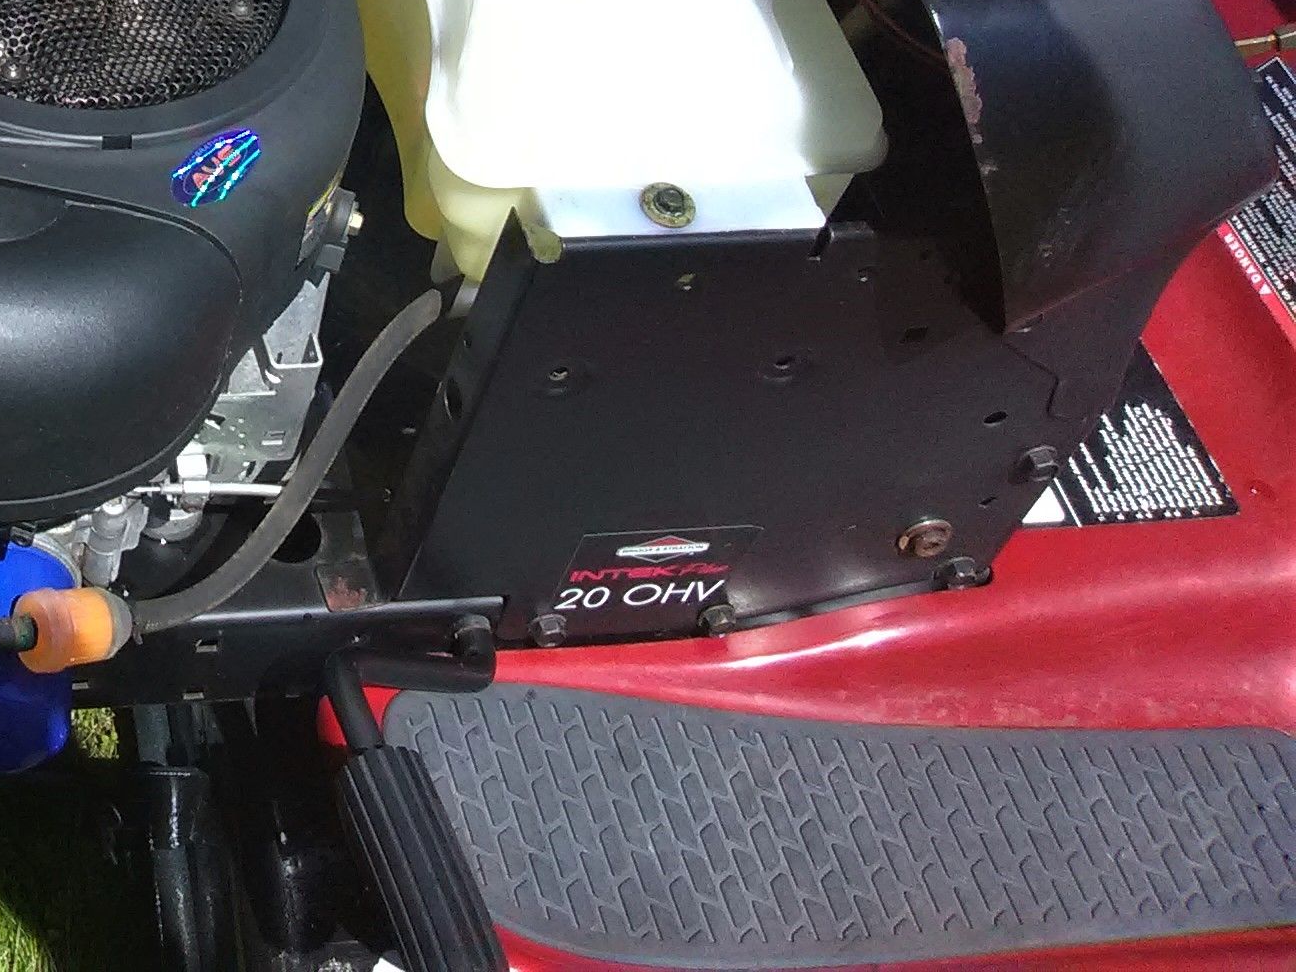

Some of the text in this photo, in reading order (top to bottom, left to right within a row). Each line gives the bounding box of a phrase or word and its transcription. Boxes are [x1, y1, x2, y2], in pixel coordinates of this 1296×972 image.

[1221, 231, 1263, 285] DANGER
[569, 564, 675, 583] INTEK
[554, 579, 725, 610] 20 OHV
